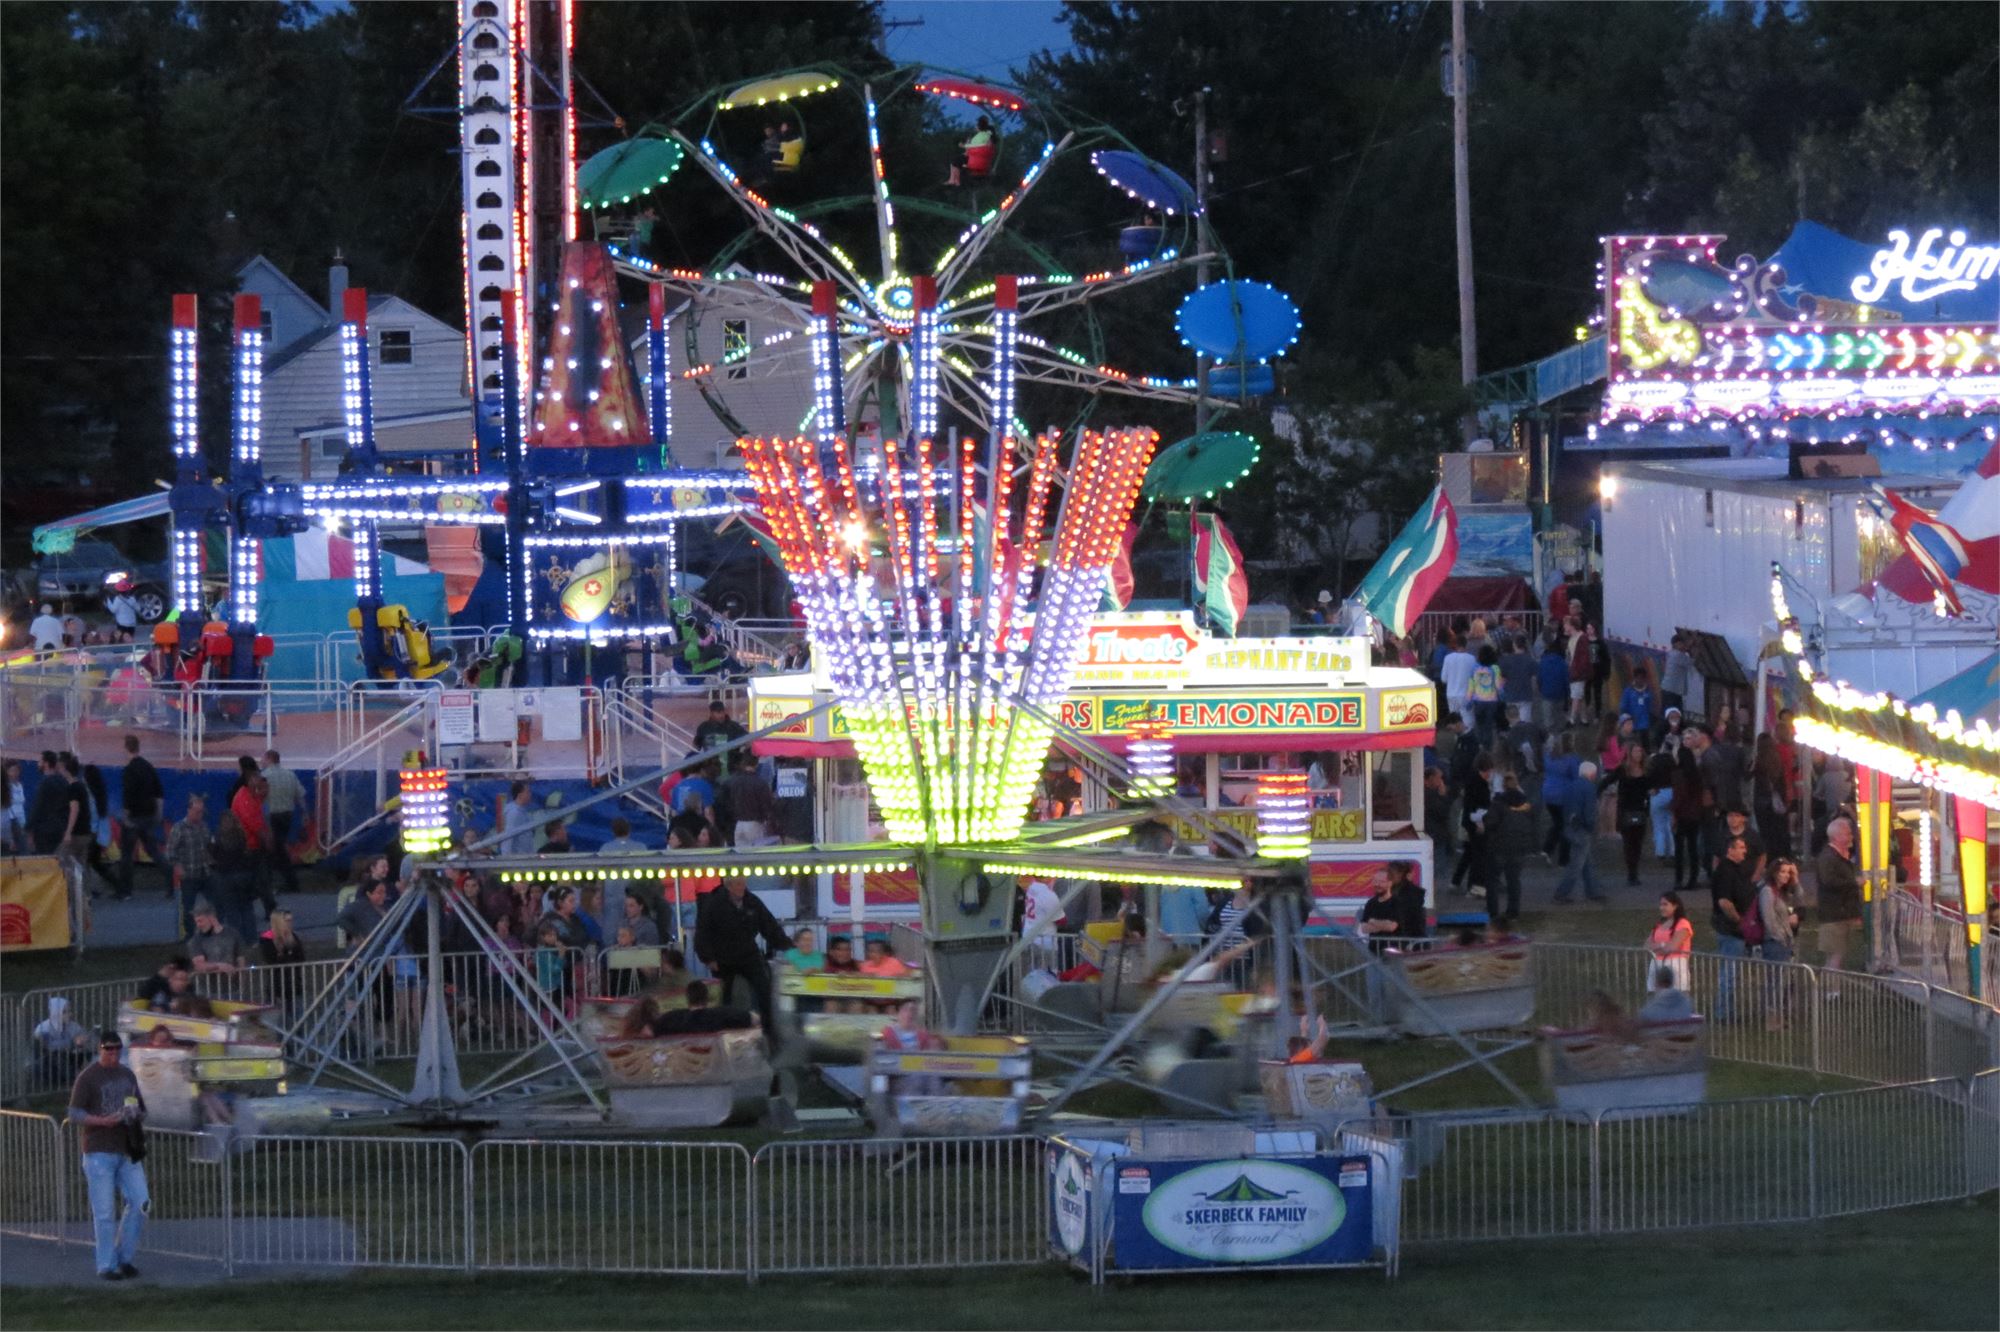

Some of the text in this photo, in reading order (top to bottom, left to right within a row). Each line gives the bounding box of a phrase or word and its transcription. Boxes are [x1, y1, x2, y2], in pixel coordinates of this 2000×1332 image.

[1095, 631, 1188, 662] Treats
[1206, 649, 1352, 672] ELEPHANT EARS
[1157, 702, 1360, 728] LEMONADE
[1308, 813, 1357, 839] ARS
[1185, 1206, 1307, 1225] SKERBECK FAMILY
[1211, 1230, 1280, 1246] Carnival
